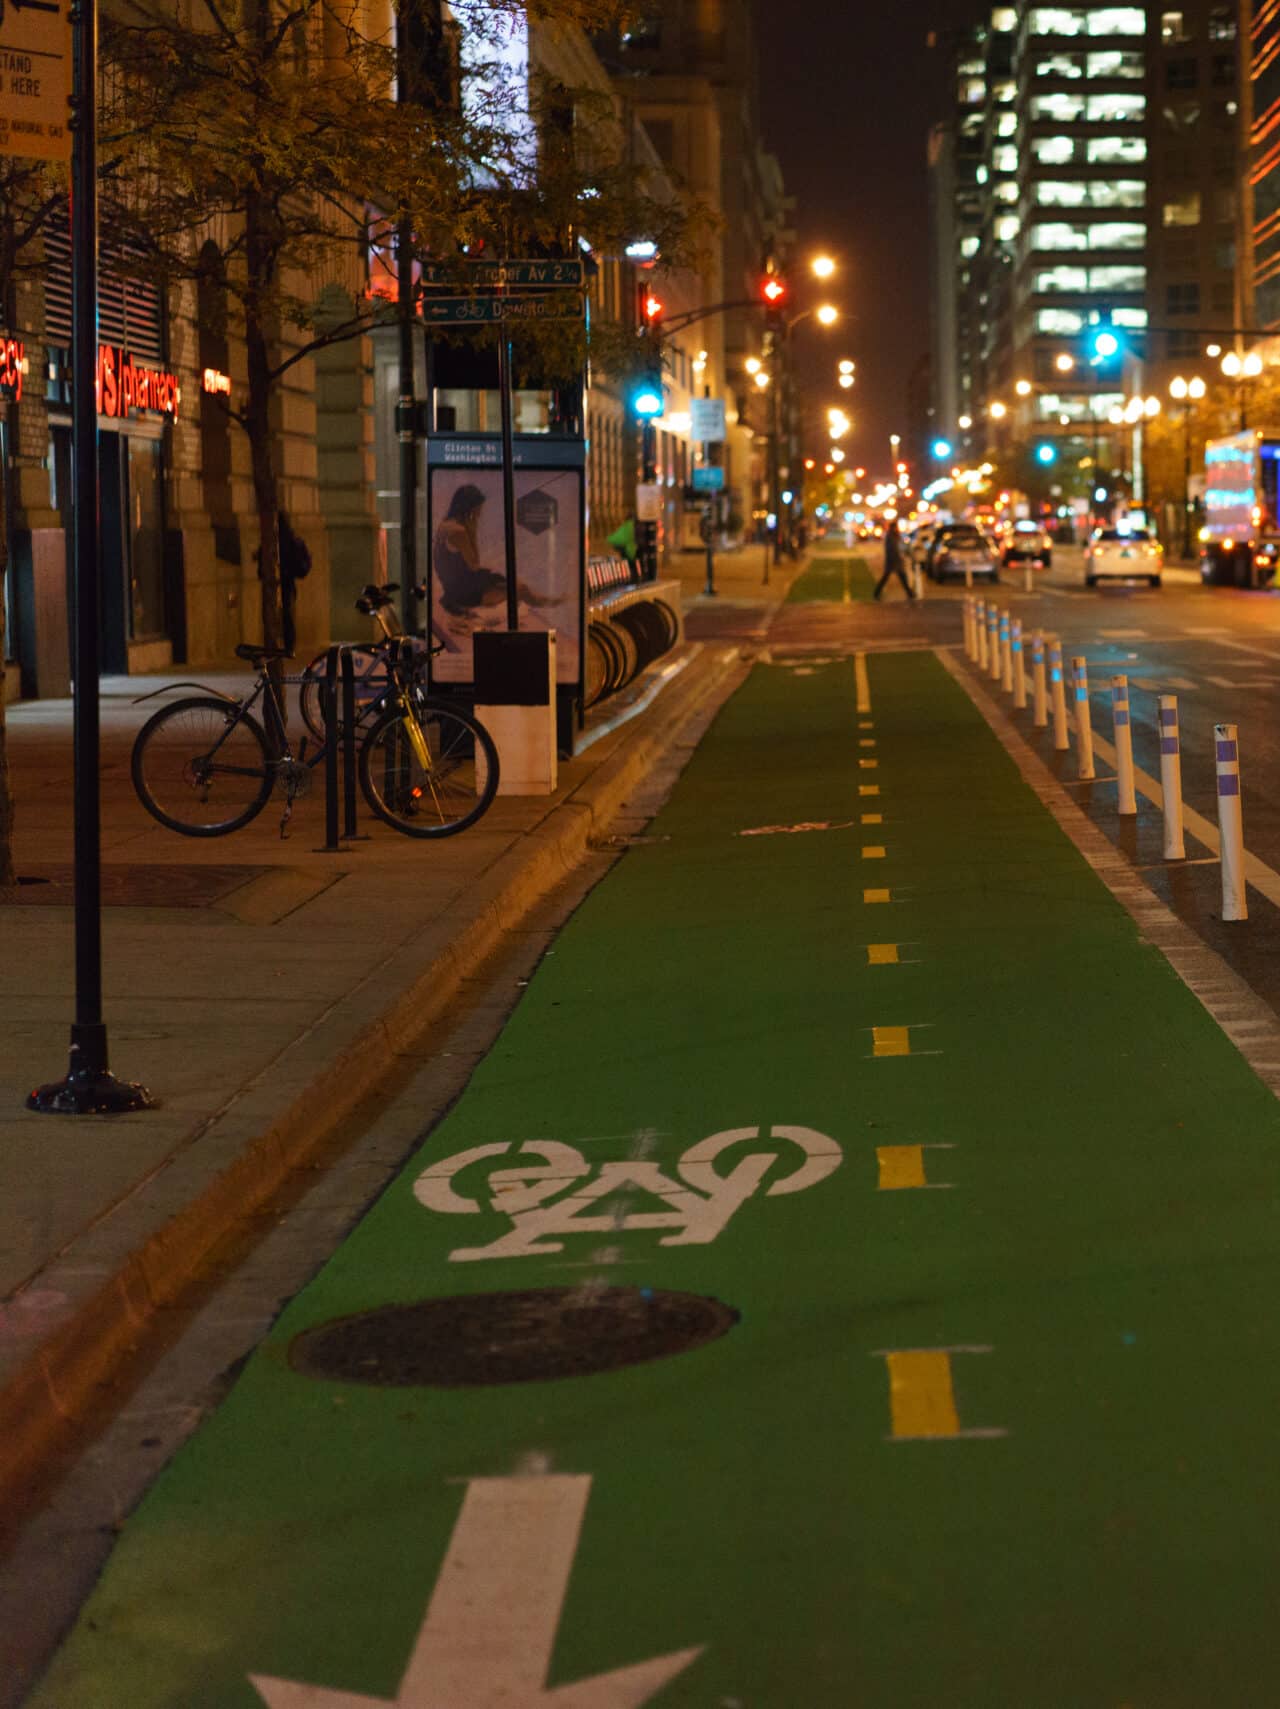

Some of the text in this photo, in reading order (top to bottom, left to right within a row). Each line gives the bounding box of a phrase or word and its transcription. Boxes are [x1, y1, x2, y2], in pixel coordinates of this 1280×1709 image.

[10, 77, 41, 97] HERE
[528, 265, 546, 280] Av
[492, 300, 566, 317] Downton
